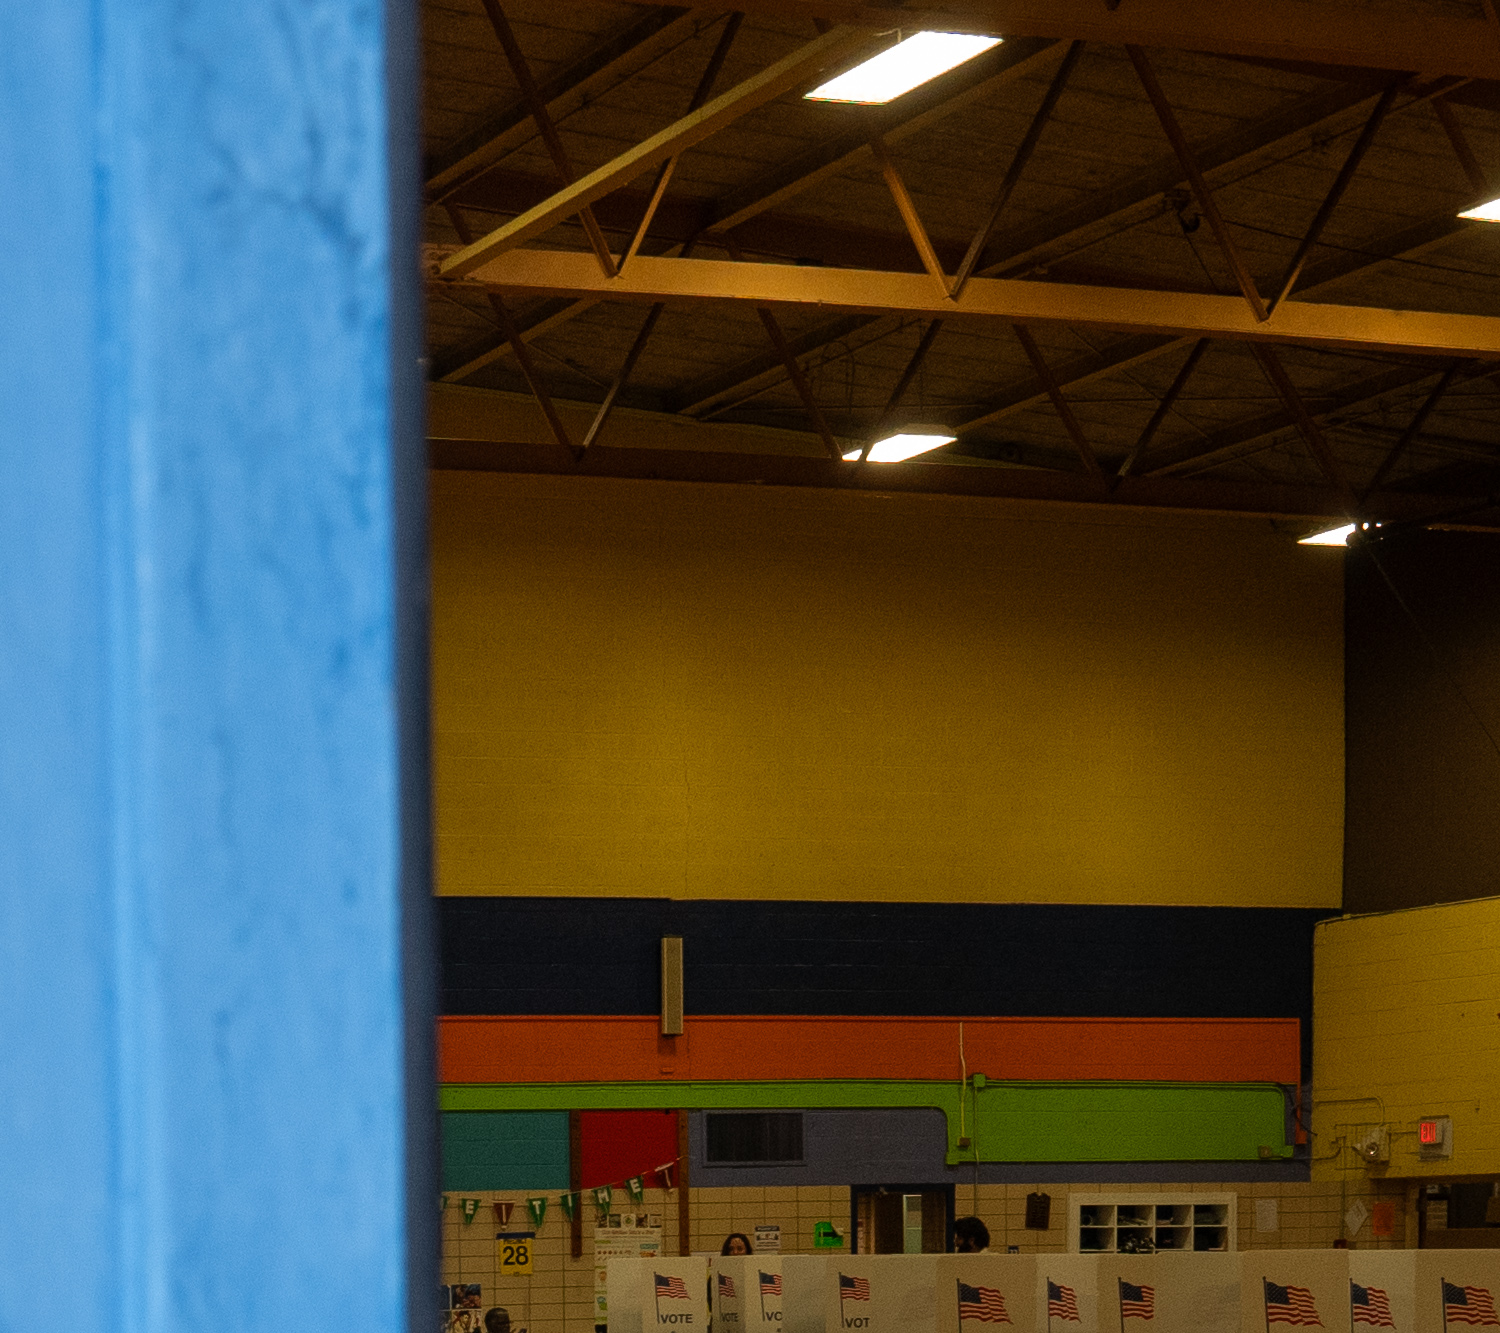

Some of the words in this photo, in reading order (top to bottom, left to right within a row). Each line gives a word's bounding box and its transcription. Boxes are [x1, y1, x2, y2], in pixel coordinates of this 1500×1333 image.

[503, 1246, 529, 1265] 28
[660, 1314, 693, 1324] VOTE
[721, 1313, 738, 1322] VOTE
[766, 1312, 782, 1321] VO
[845, 1318, 869, 1327] VOT
